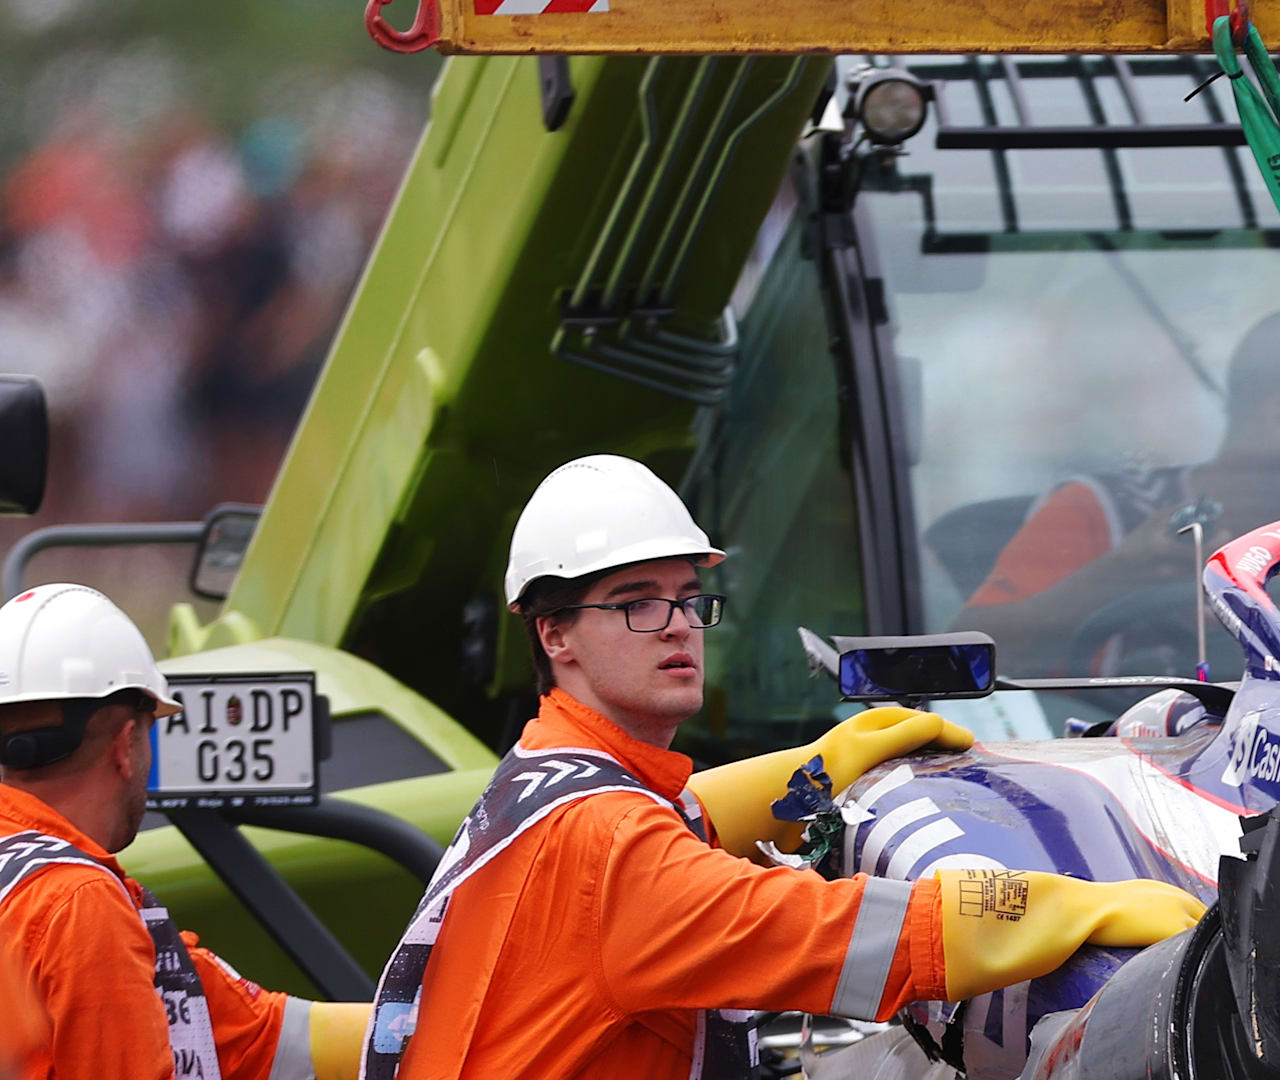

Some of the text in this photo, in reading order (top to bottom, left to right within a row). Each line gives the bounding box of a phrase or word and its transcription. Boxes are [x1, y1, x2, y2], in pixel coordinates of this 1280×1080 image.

[1236, 546, 1273, 576] HUGO
[166, 689, 303, 735] AI DP
[198, 740, 274, 783] 035
